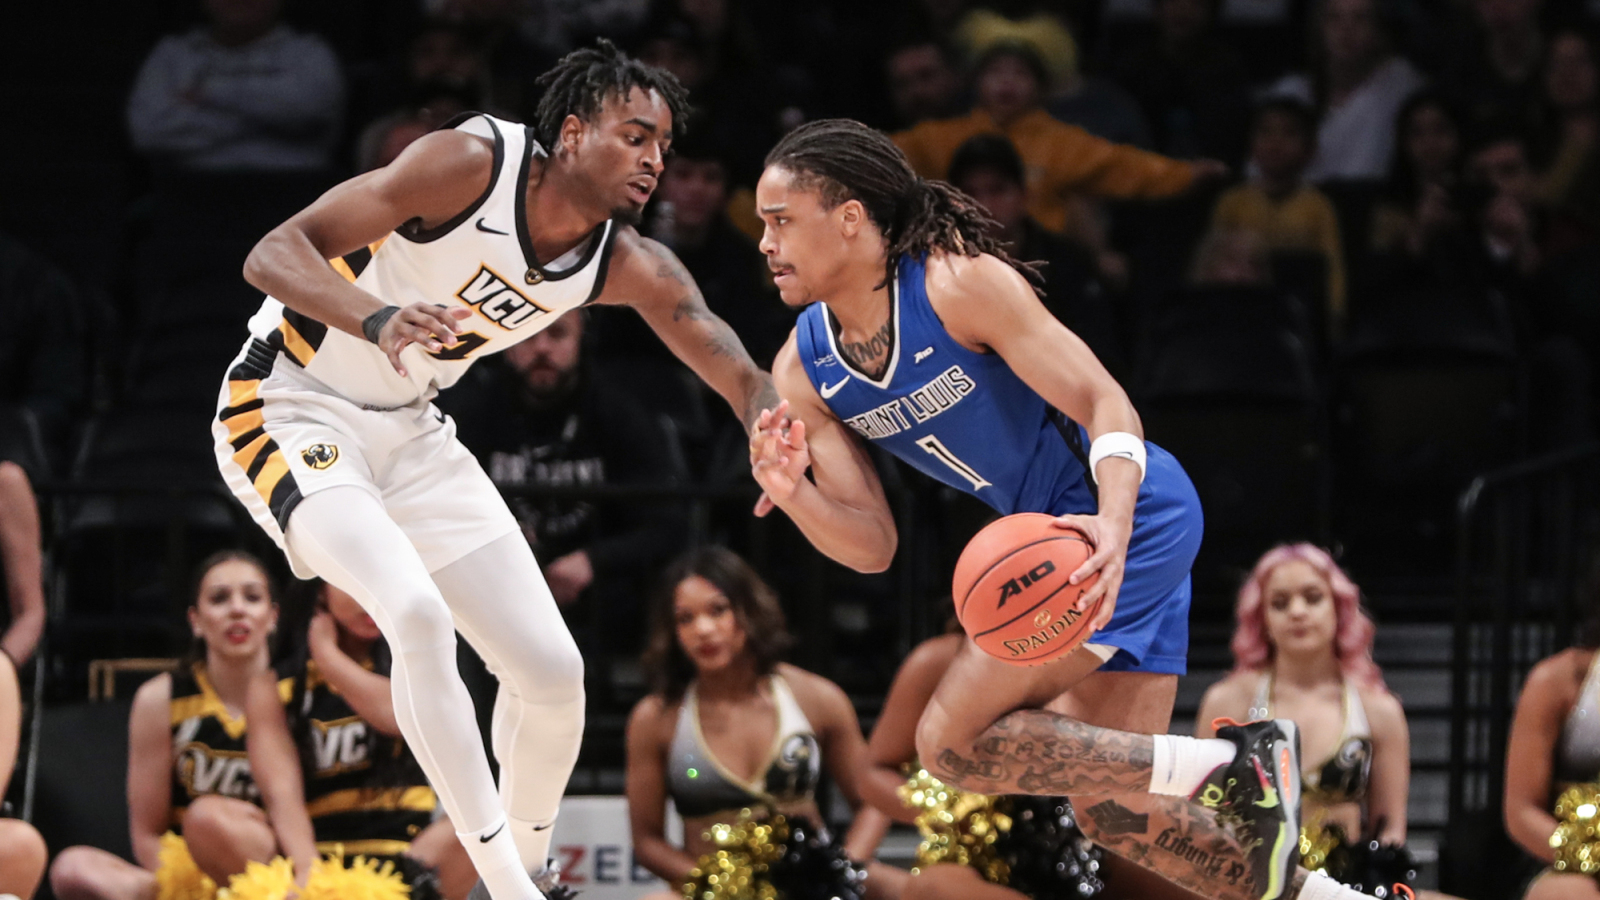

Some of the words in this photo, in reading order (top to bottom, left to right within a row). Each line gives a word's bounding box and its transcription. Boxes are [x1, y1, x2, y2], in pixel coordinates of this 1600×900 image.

[454, 263, 553, 331] VCU
[900, 365, 976, 424] LOUIS
[915, 434, 992, 491] 1
[997, 560, 1056, 610] A10
